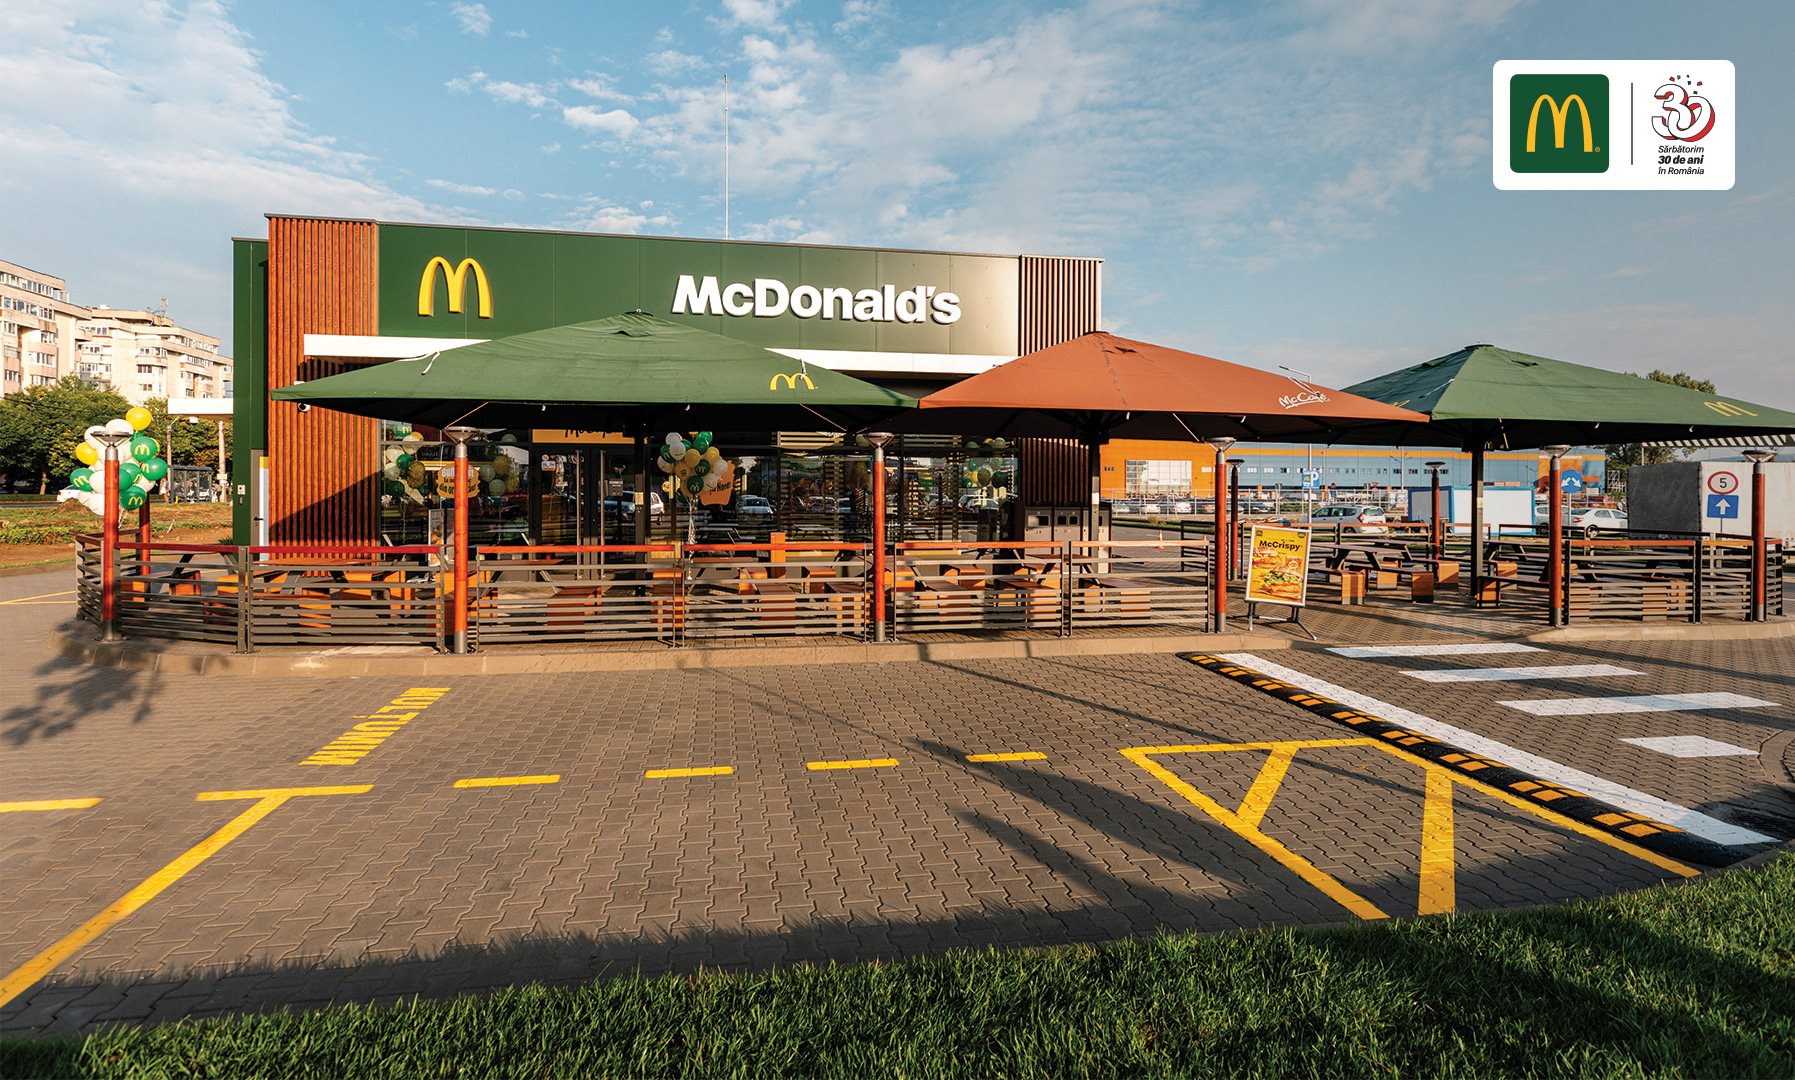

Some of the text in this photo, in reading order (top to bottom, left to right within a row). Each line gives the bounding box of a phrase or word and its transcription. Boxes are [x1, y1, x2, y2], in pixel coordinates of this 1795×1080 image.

[418, 256, 491, 318] M
[672, 274, 962, 325] McDonald's
[1310, 471, 1319, 487] P
[1719, 477, 1728, 489] 5
[1259, 540, 1301, 552] McCrispy
